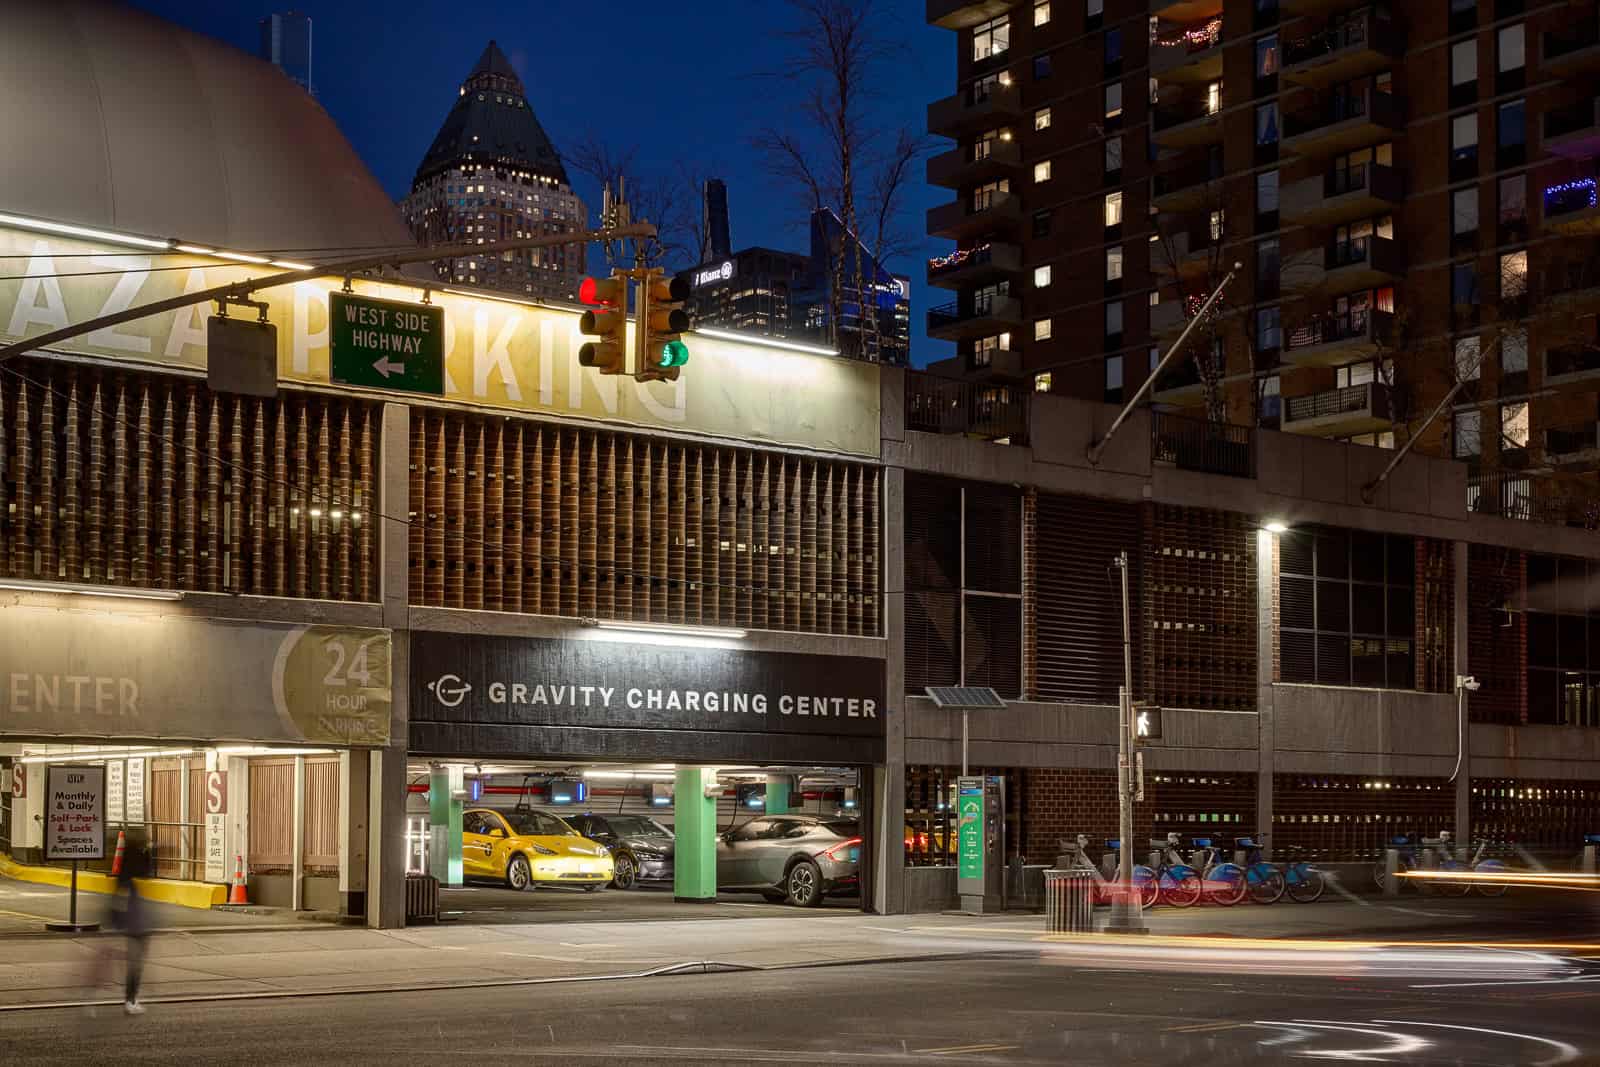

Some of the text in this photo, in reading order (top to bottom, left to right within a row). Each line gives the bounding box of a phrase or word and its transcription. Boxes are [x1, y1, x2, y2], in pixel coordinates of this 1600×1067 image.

[345, 304, 430, 332] WEST SIDE
[353, 329, 422, 354] HIGHWAY
[323, 641, 369, 688] 24
[10, 672, 139, 717] ENTER
[326, 693, 367, 711] HOUR
[488, 682, 615, 707] GRAVITY
[626, 687, 768, 714] CHARGING
[778, 694, 877, 718] CENTER
[55, 792, 95, 801] Monthly
[208, 771, 222, 813] S
[68, 802, 93, 811] Daily
[70, 824, 91, 832] Lock
[51, 845, 99, 854] Available
[57, 836, 92, 845] Spaces
